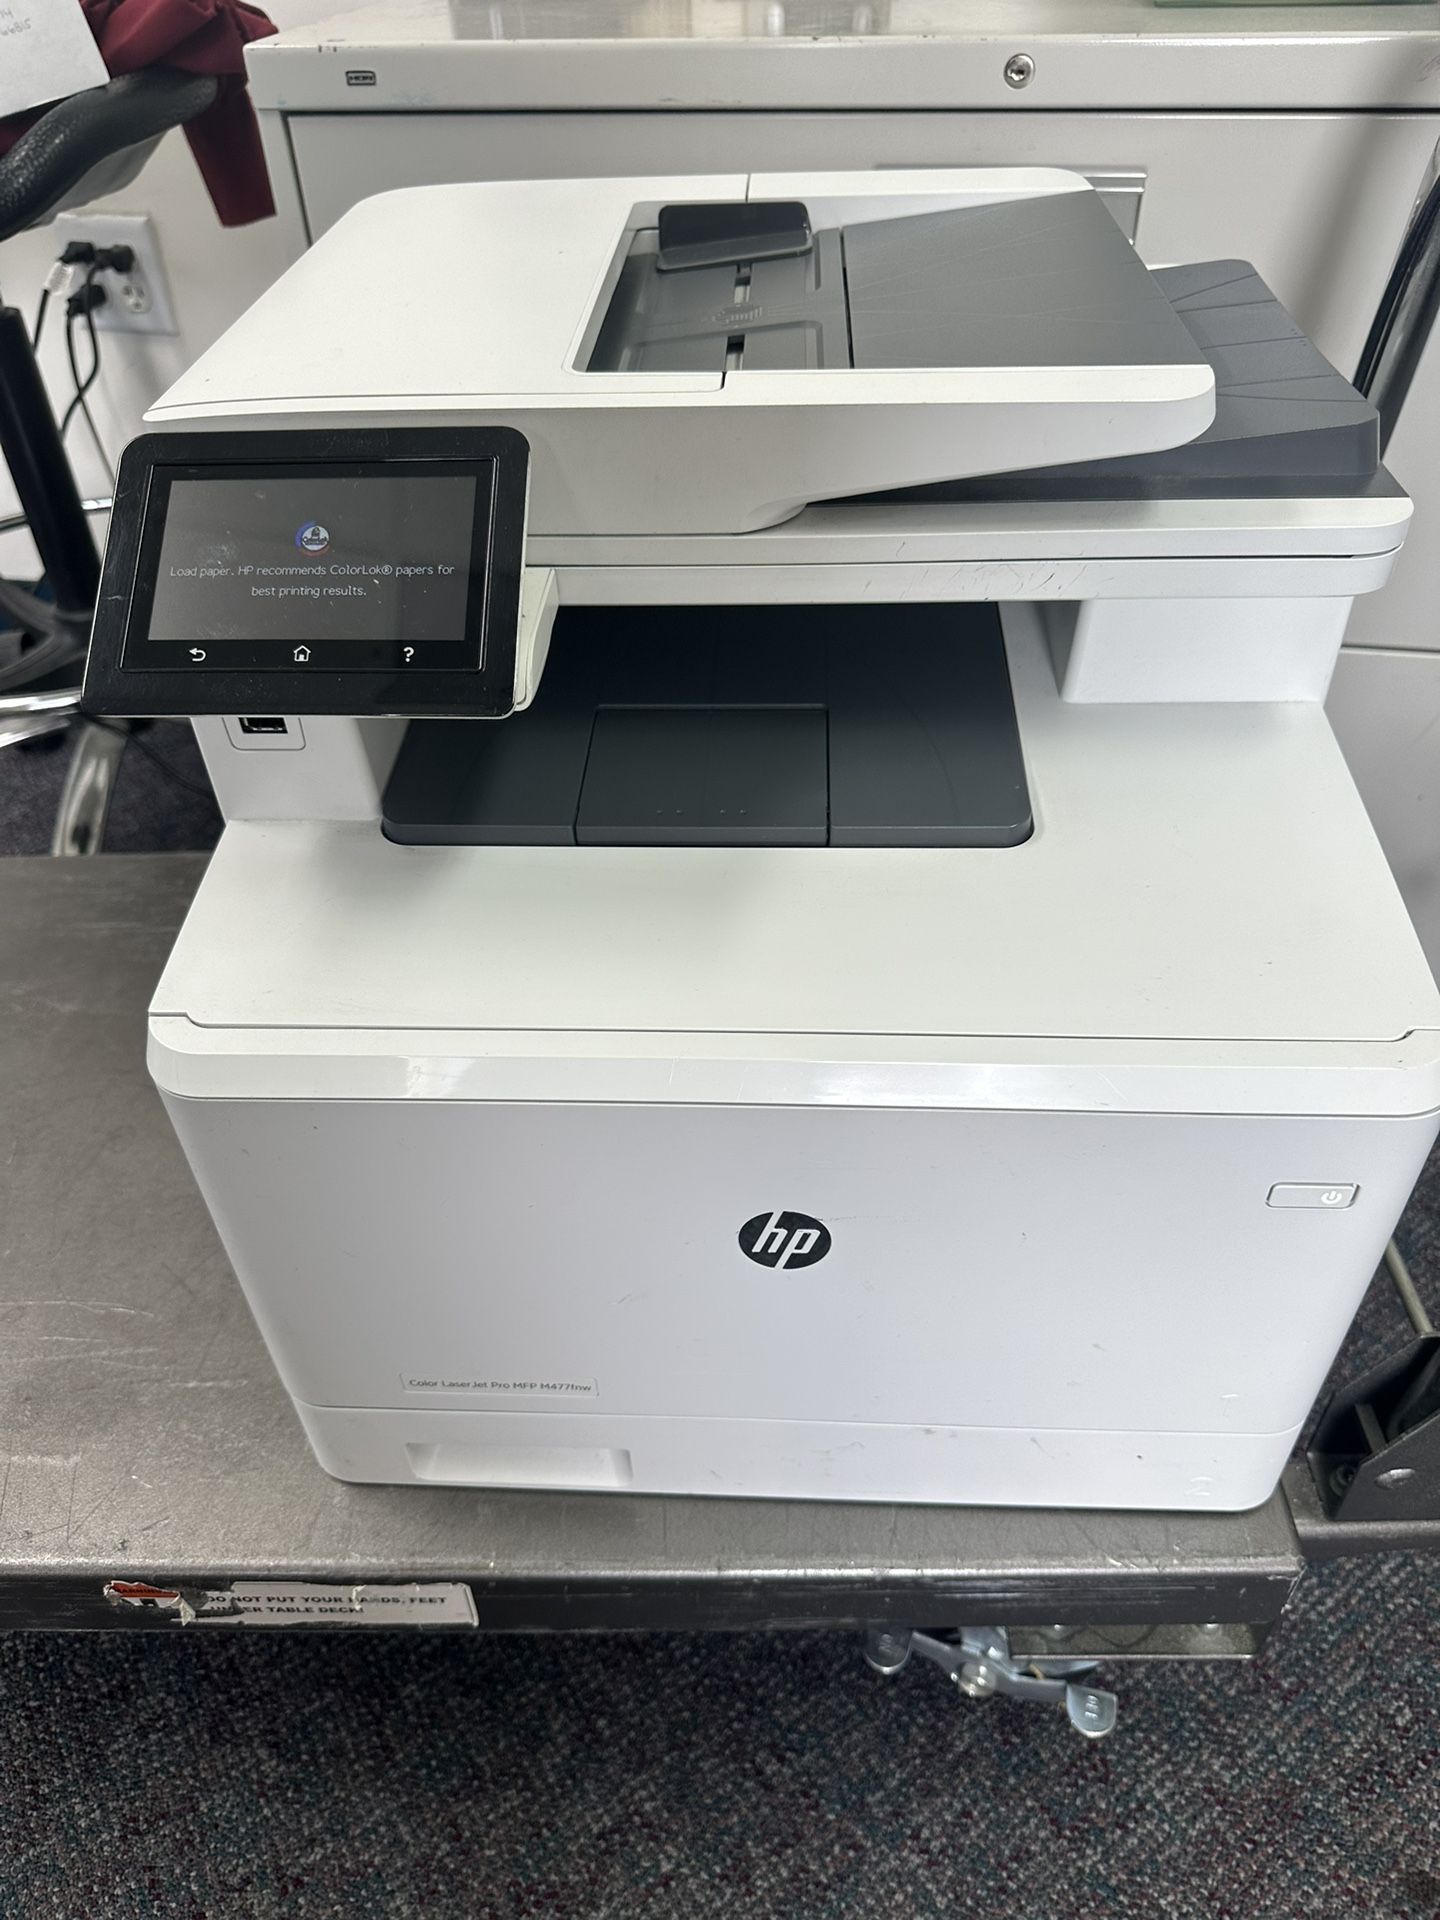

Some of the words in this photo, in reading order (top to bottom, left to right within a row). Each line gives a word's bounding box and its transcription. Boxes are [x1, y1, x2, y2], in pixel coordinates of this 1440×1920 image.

[170, 566, 198, 577] Load
[199, 567, 235, 579] paper.
[238, 565, 254, 576] HP
[256, 564, 327, 576] recommends
[395, 565, 434, 578] papers
[437, 564, 456, 575] for
[251, 586, 276, 597] best
[278, 585, 320, 599] printing
[323, 585, 367, 596] results.
[738, 1210, 832, 1270] hp
[409, 1379, 438, 1388] Color
[441, 1379, 488, 1389] LaserJet
[490, 1381, 511, 1390] Pro
[513, 1382, 538, 1390] MFP
[540, 1382, 592, 1392] M477fnw
[232, 1595, 262, 1603] NOT
